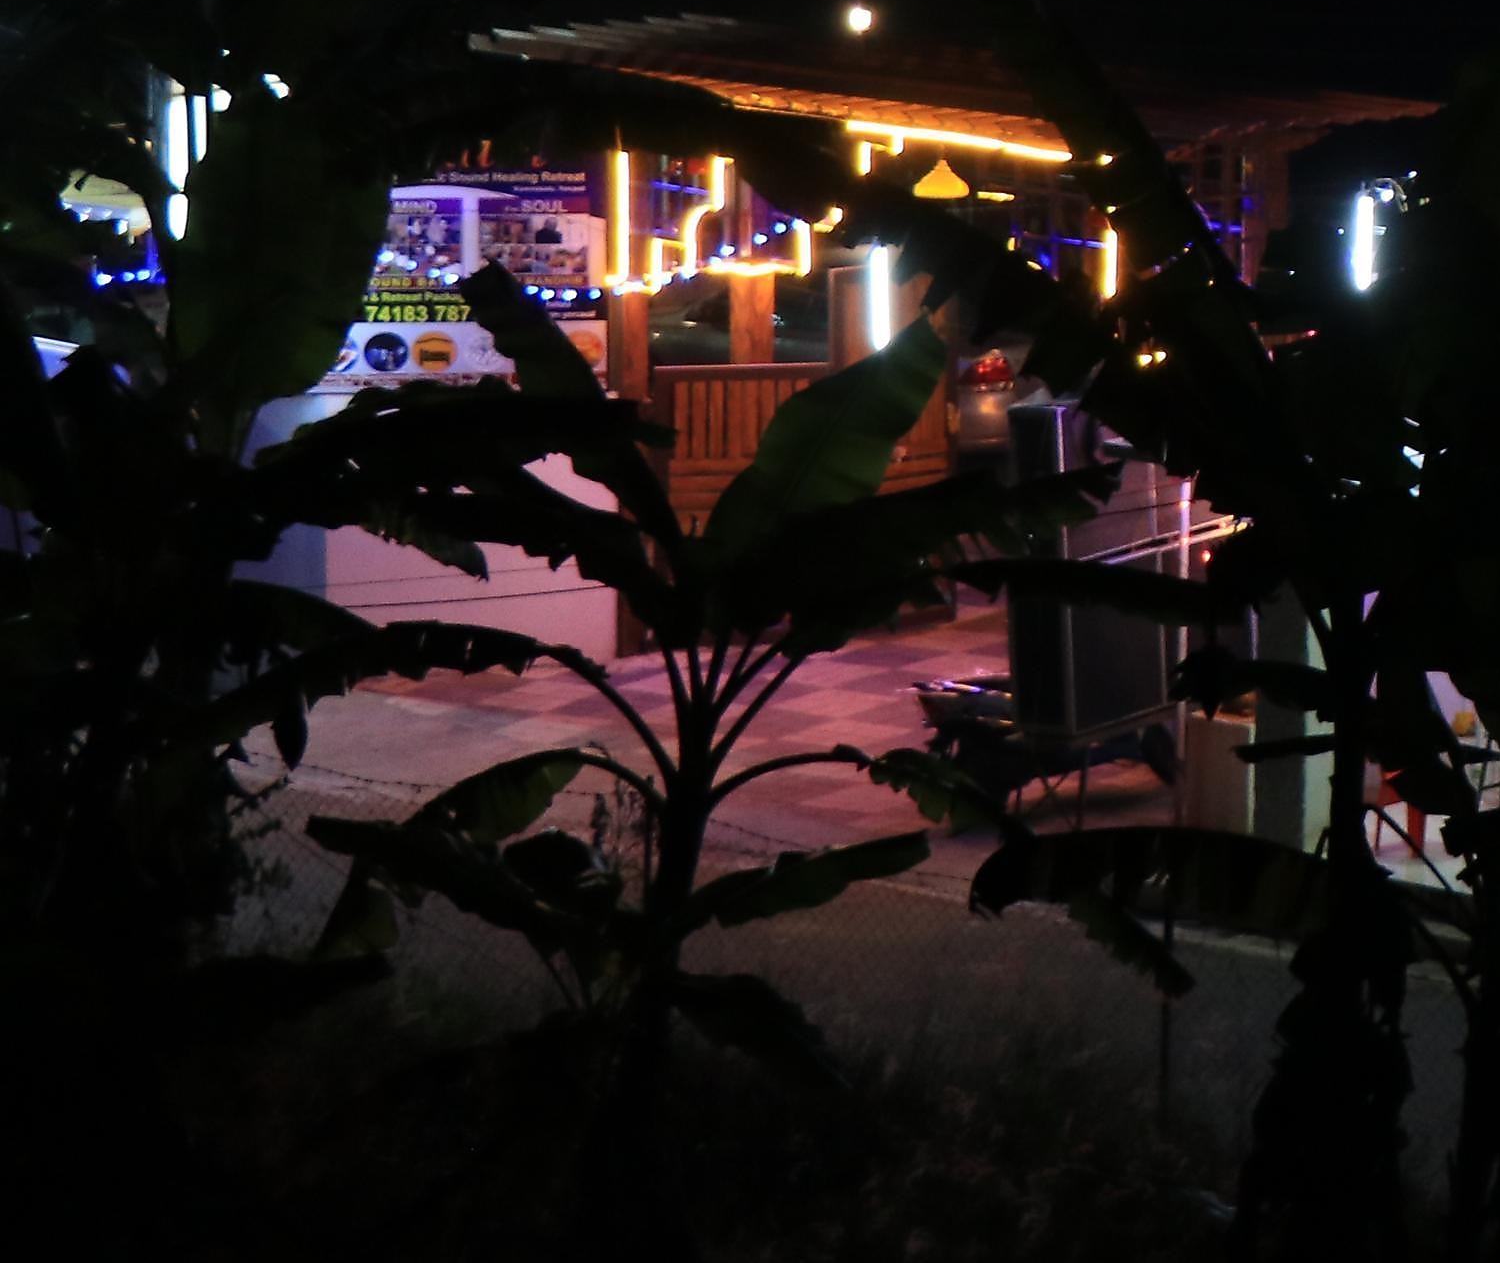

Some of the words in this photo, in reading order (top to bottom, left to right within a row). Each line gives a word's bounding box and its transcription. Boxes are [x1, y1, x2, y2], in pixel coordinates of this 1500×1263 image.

[492, 171, 539, 185] Healing
[540, 171, 586, 183] Retreat
[520, 199, 568, 213] SOUL
[370, 277, 412, 287] OUND
